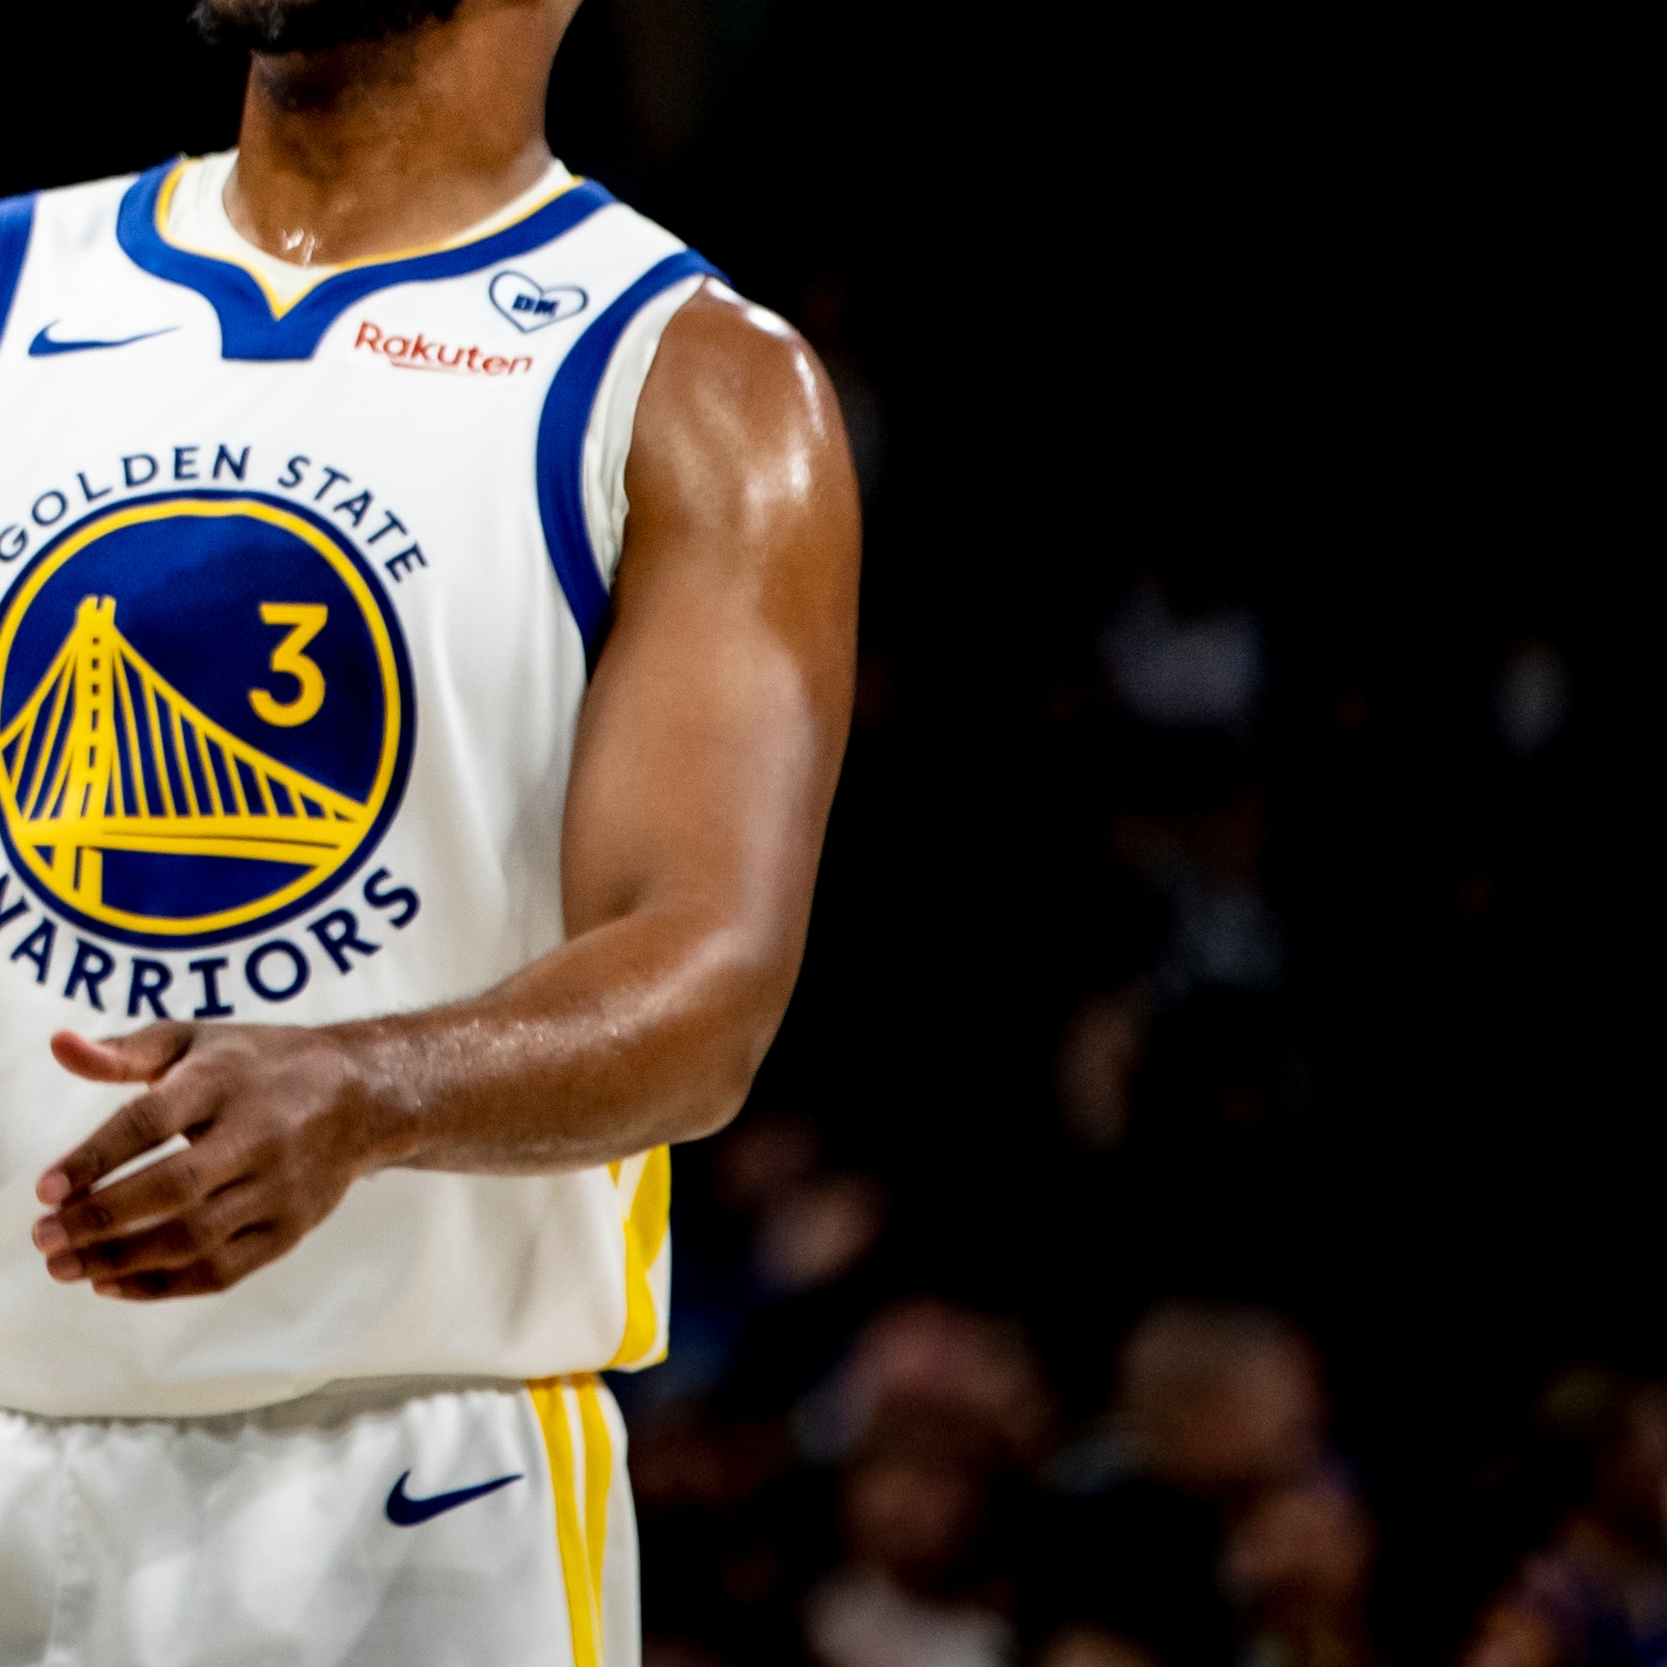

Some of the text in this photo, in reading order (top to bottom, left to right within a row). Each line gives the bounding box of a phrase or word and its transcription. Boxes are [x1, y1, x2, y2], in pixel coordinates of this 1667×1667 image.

[354, 321, 534, 375] Rakuten
[277, 454, 429, 584] STATE
[247, 603, 328, 728] 3
